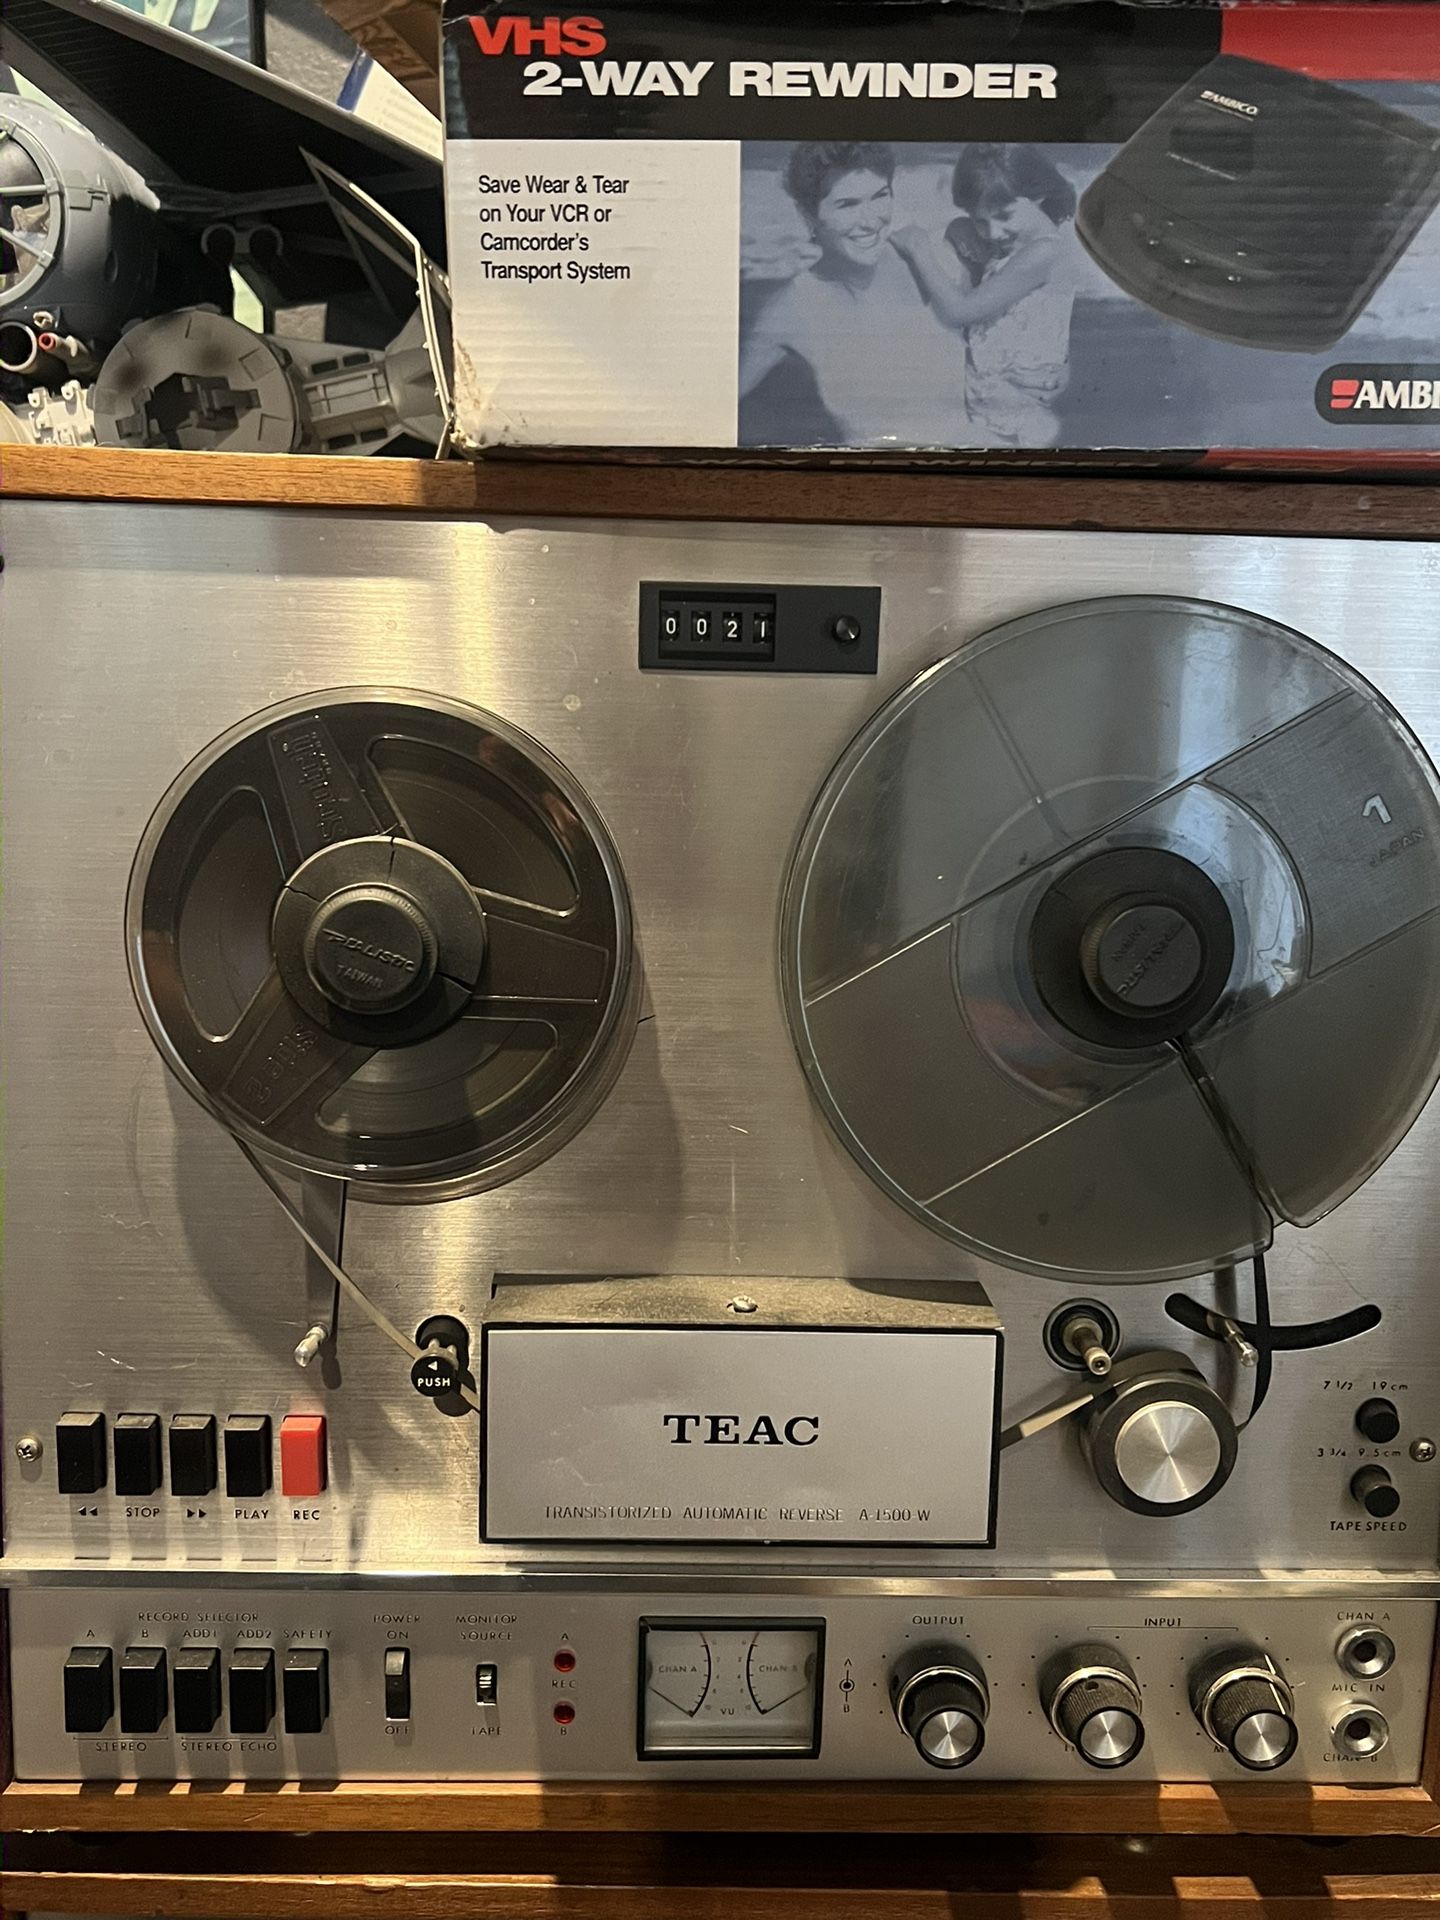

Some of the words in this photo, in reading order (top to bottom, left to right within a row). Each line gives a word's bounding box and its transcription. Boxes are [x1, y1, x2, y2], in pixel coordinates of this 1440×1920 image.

[468, 15, 607, 56] VHS
[523, 60, 714, 97] 2-WAY
[729, 60, 1059, 100] REWINDER
[479, 174, 521, 194] Save
[525, 174, 570, 194] Wear
[575, 175, 588, 194] &
[592, 175, 630, 194] Tear
[479, 207, 502, 223] on
[506, 203, 546, 223] Your
[550, 203, 589, 223] VCR
[594, 207, 612, 223] or
[480, 232, 590, 251] Camcorder's
[481, 260, 563, 284] Transport
[567, 260, 631, 284] System
[417, 1377, 451, 1388] PUSH
[663, 1414, 820, 1446] TEAC
[126, 1506, 161, 1518] STOP
[235, 1509, 270, 1520] PLAY
[293, 1509, 321, 1521] REC
[545, 1505, 672, 1521] TRANSISTORIZED
[683, 1506, 768, 1521] AUTOMATIC
[779, 1507, 844, 1522] REVERSE
[1330, 1521, 1362, 1532] TAPE
[1366, 1521, 1407, 1532] SPEED
[138, 1612, 190, 1623] RECORD
[197, 1612, 259, 1623] SELECTOR
[373, 1614, 421, 1625] POWER
[455, 1614, 518, 1625] MONITOR
[912, 1615, 964, 1625] OUTPUT
[1337, 1611, 1374, 1621] CHAN
[1383, 1611, 1391, 1621] A
[1144, 1617, 1182, 1627] INPUT
[86, 1629, 96, 1638] A
[141, 1629, 149, 1638] B
[283, 1629, 333, 1639] SAFETY
[386, 1630, 409, 1640] ON
[460, 1631, 513, 1641] SOURCE
[561, 1632, 569, 1641] A
[658, 1664, 687, 1673] CHAN
[690, 1665, 698, 1673] A
[551, 1679, 577, 1689] REC
[1331, 1683, 1358, 1693] MIC
[1370, 1684, 1386, 1692] IN
[720, 1708, 735, 1716] VU
[843, 1703, 851, 1713] B
[384, 1725, 410, 1735] OFF
[472, 1726, 502, 1736] TAPE
[560, 1727, 568, 1736] B
[96, 1741, 147, 1752] STEREO
[181, 1741, 233, 1752] STEREO
[240, 1742, 278, 1752] ECHO
